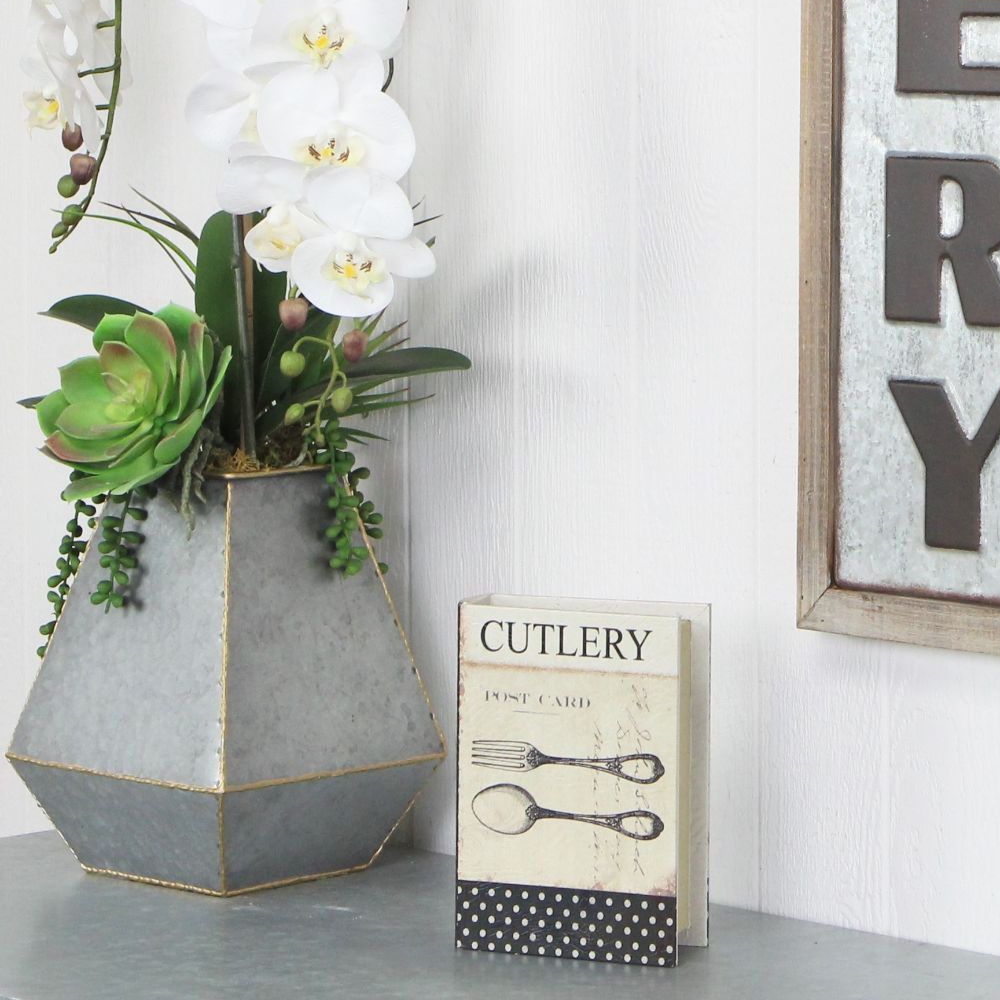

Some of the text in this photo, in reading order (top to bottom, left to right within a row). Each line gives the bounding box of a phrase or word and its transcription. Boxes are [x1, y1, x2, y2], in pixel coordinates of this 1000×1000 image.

[480, 619, 653, 662] CUTLERY
[484, 690, 591, 709] POST CARD
